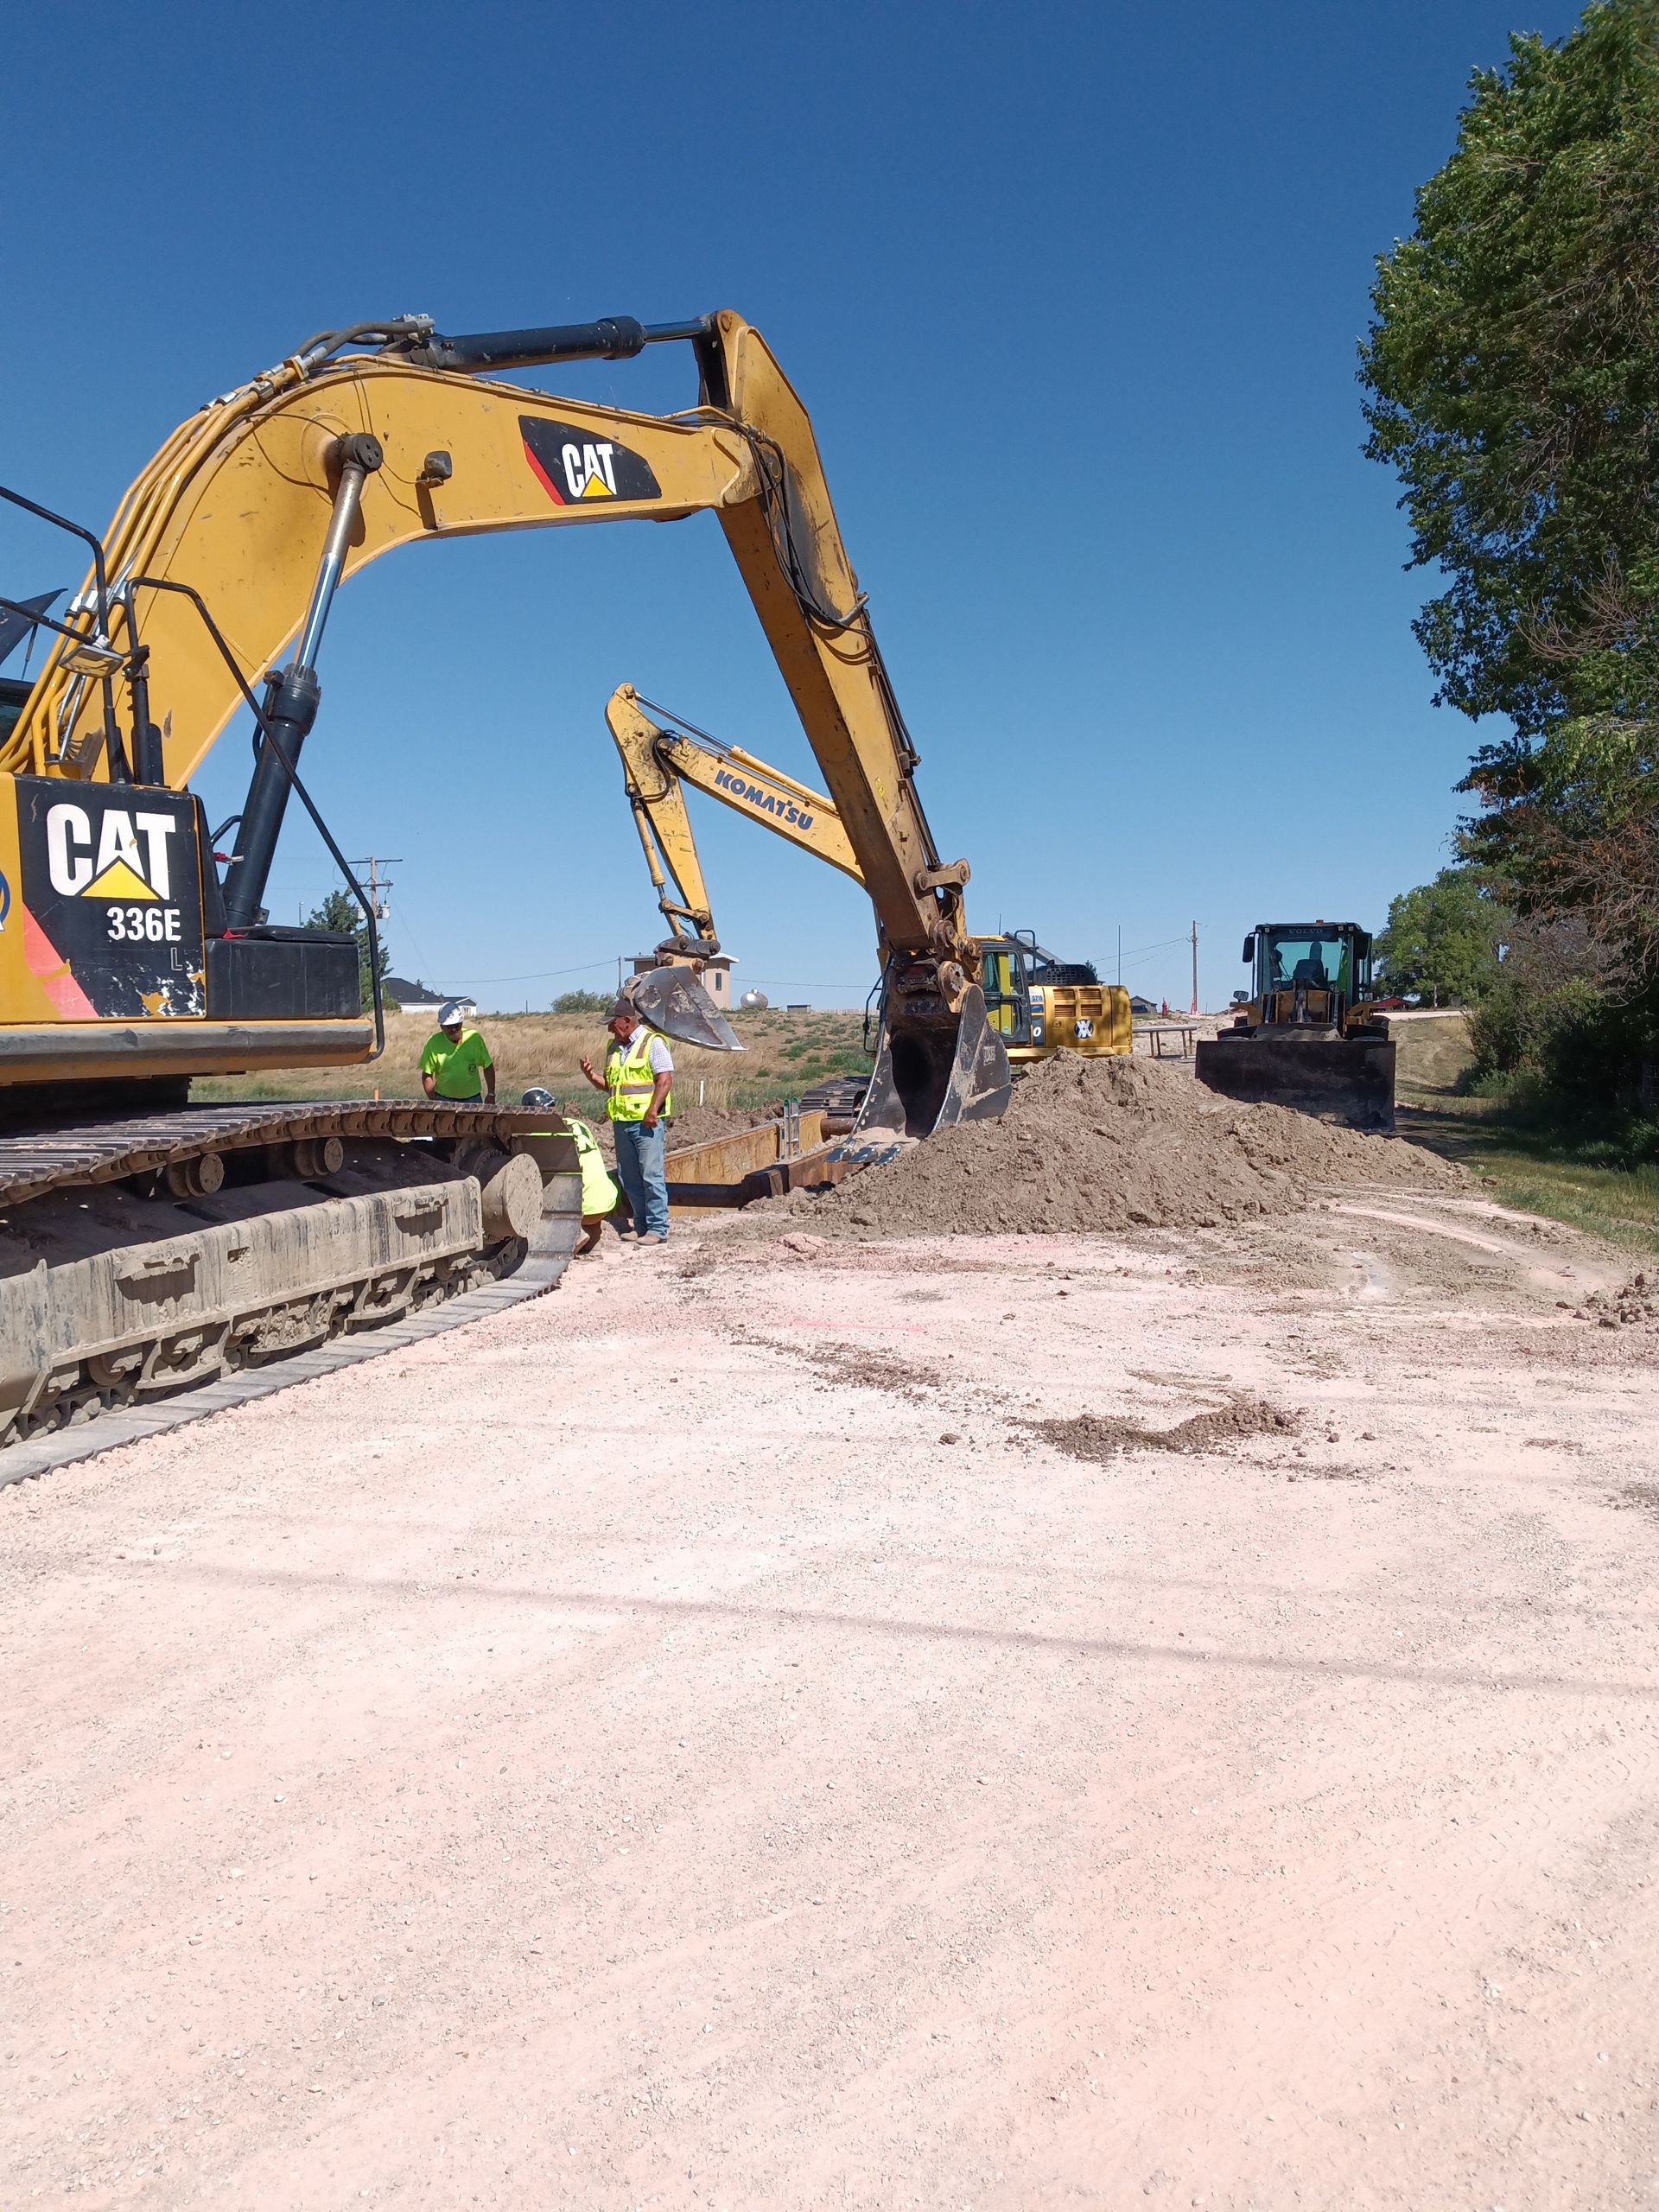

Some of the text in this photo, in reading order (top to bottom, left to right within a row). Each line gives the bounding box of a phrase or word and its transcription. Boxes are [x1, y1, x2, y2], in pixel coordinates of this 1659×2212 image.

[562, 443, 617, 498] CAT
[714, 769, 814, 830] KOMATSU
[46, 803, 176, 901] CAT
[106, 906, 181, 942] 336E
